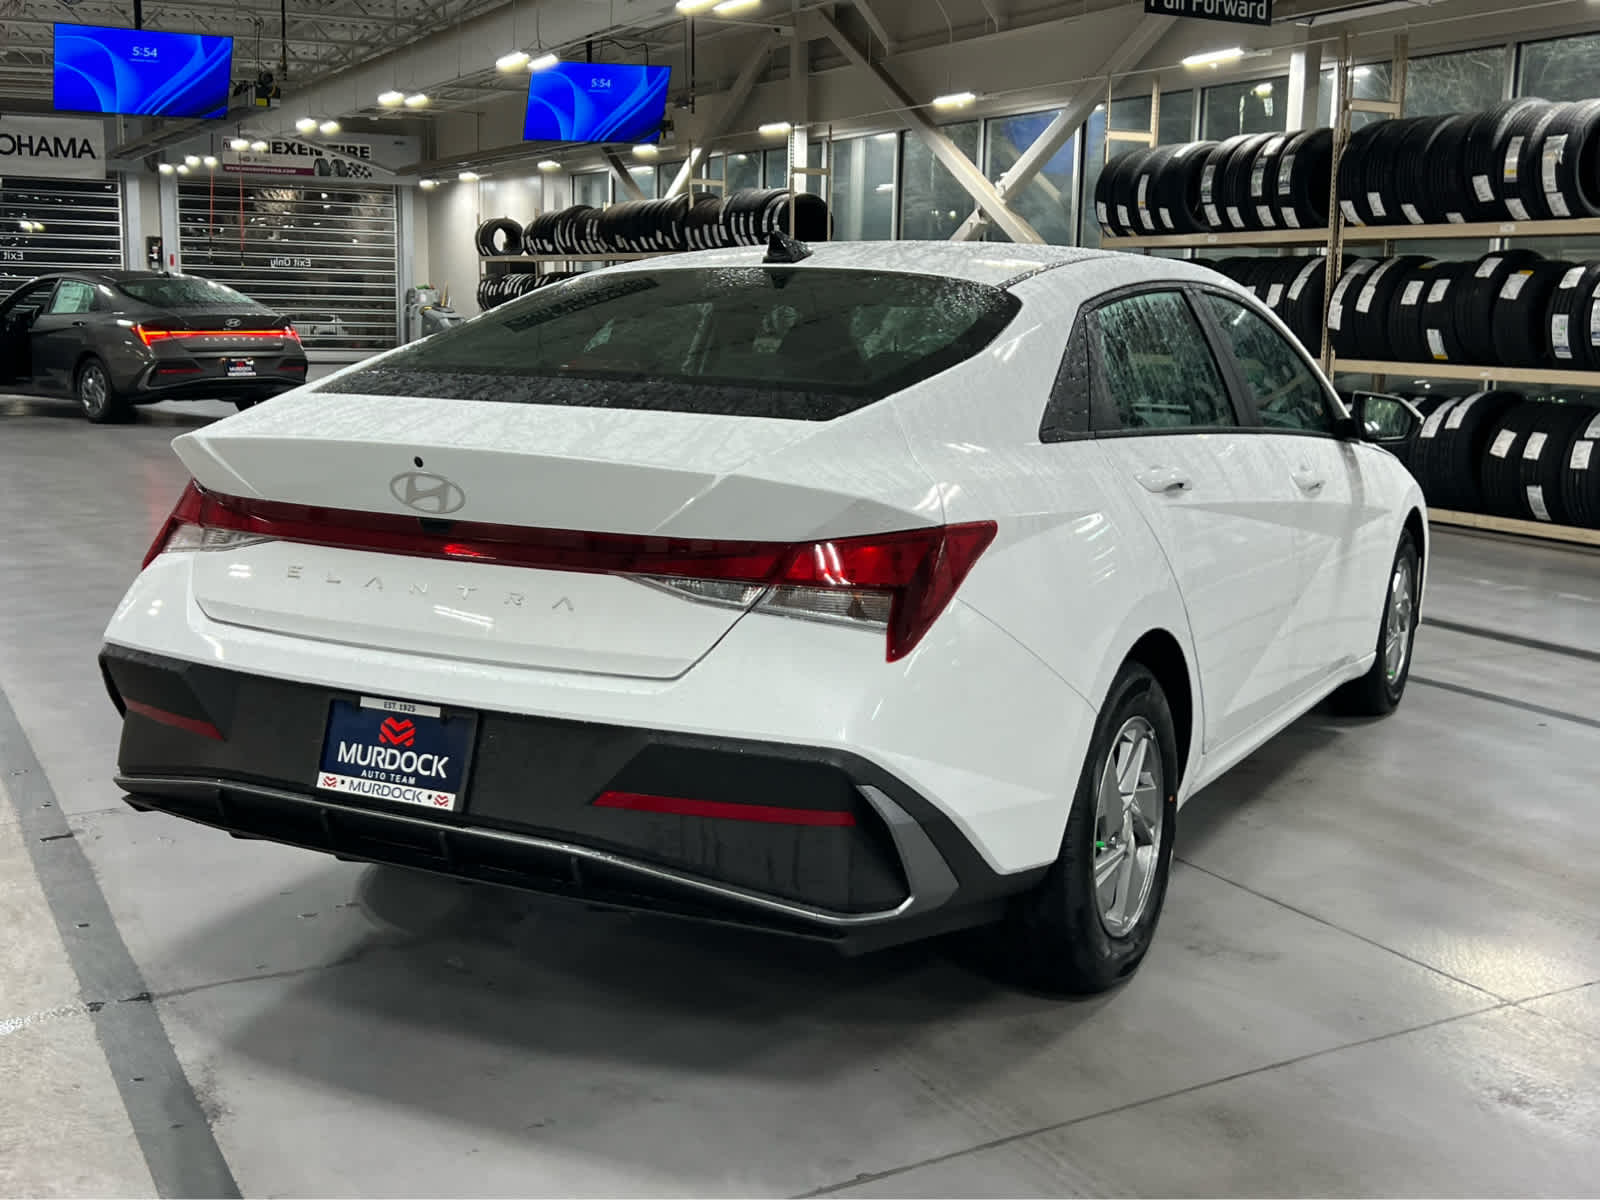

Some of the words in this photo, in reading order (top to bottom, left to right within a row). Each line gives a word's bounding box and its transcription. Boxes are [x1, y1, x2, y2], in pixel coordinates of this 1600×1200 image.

[1192, 0, 1267, 19] Forward
[132, 46, 158, 58] 5:54
[0, 133, 97, 160] OHAMA
[287, 565, 575, 613] ELANTRA
[337, 741, 449, 779] MURDOCK
[360, 769, 387, 781] AUTO
[390, 774, 417, 785] TEAM
[348, 780, 423, 803] MURDOCK
